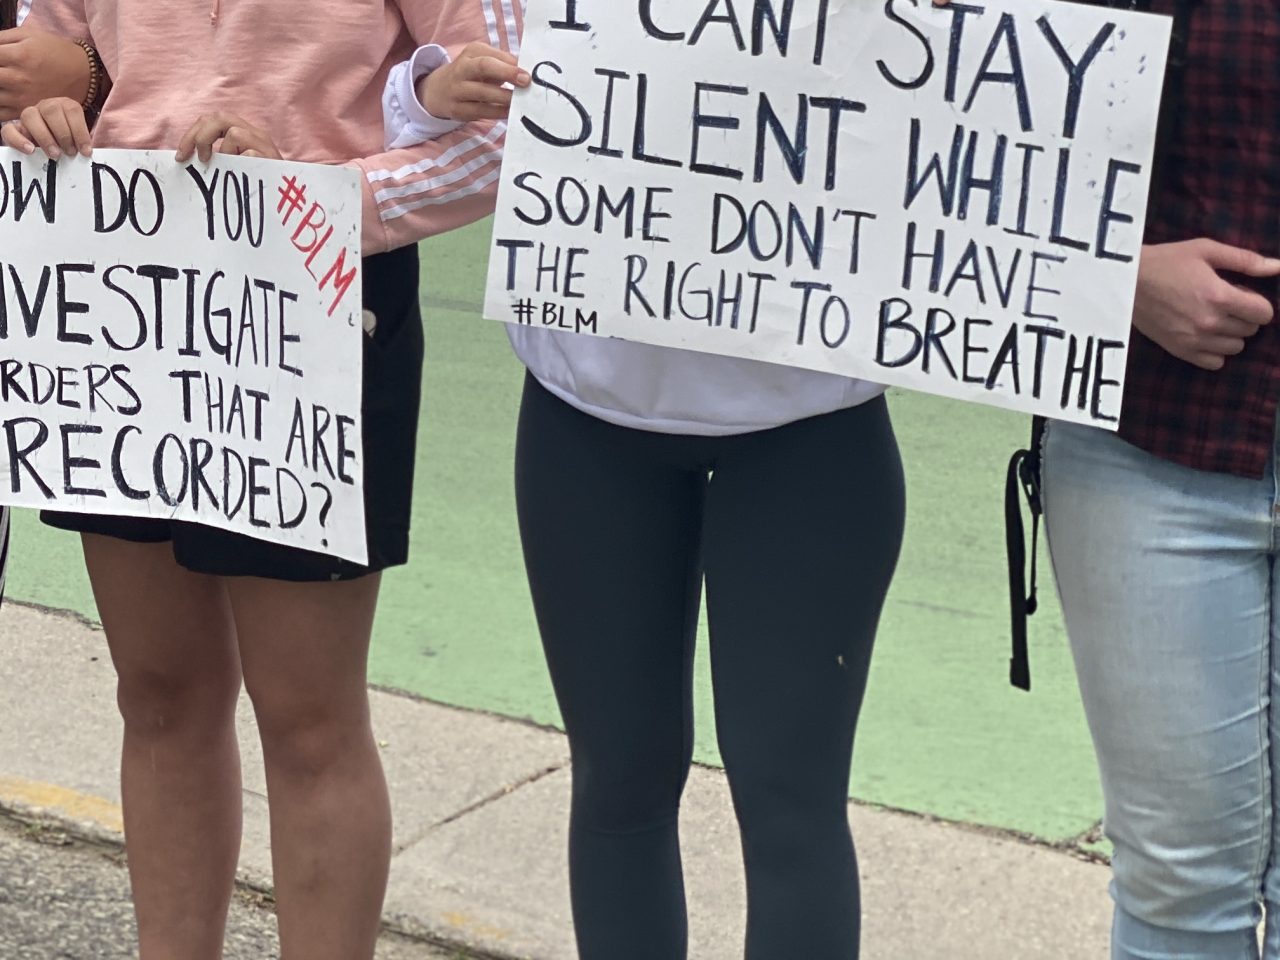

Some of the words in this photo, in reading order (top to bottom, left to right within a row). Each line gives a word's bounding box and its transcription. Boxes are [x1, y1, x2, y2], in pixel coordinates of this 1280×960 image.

[91, 162, 164, 236] DO
[186, 165, 264, 248] YOU
[520, 60, 866, 191] SILENT
[903, 118, 1141, 262] WHILE
[277, 175, 357, 316] #BLM
[513, 171, 674, 243] SOME
[711, 192, 876, 274] DON'T
[901, 221, 1067, 322] HAVE
[496, 238, 589, 299] THE
[624, 254, 776, 334] RIGHT
[789, 280, 850, 349] TO
[875, 297, 1126, 422] BREATHE
[512, 297, 599, 334] #BLM
[2, 417, 333, 548] RECORDED?
[169, 370, 269, 442] THAT
[285, 398, 356, 485] ARE
